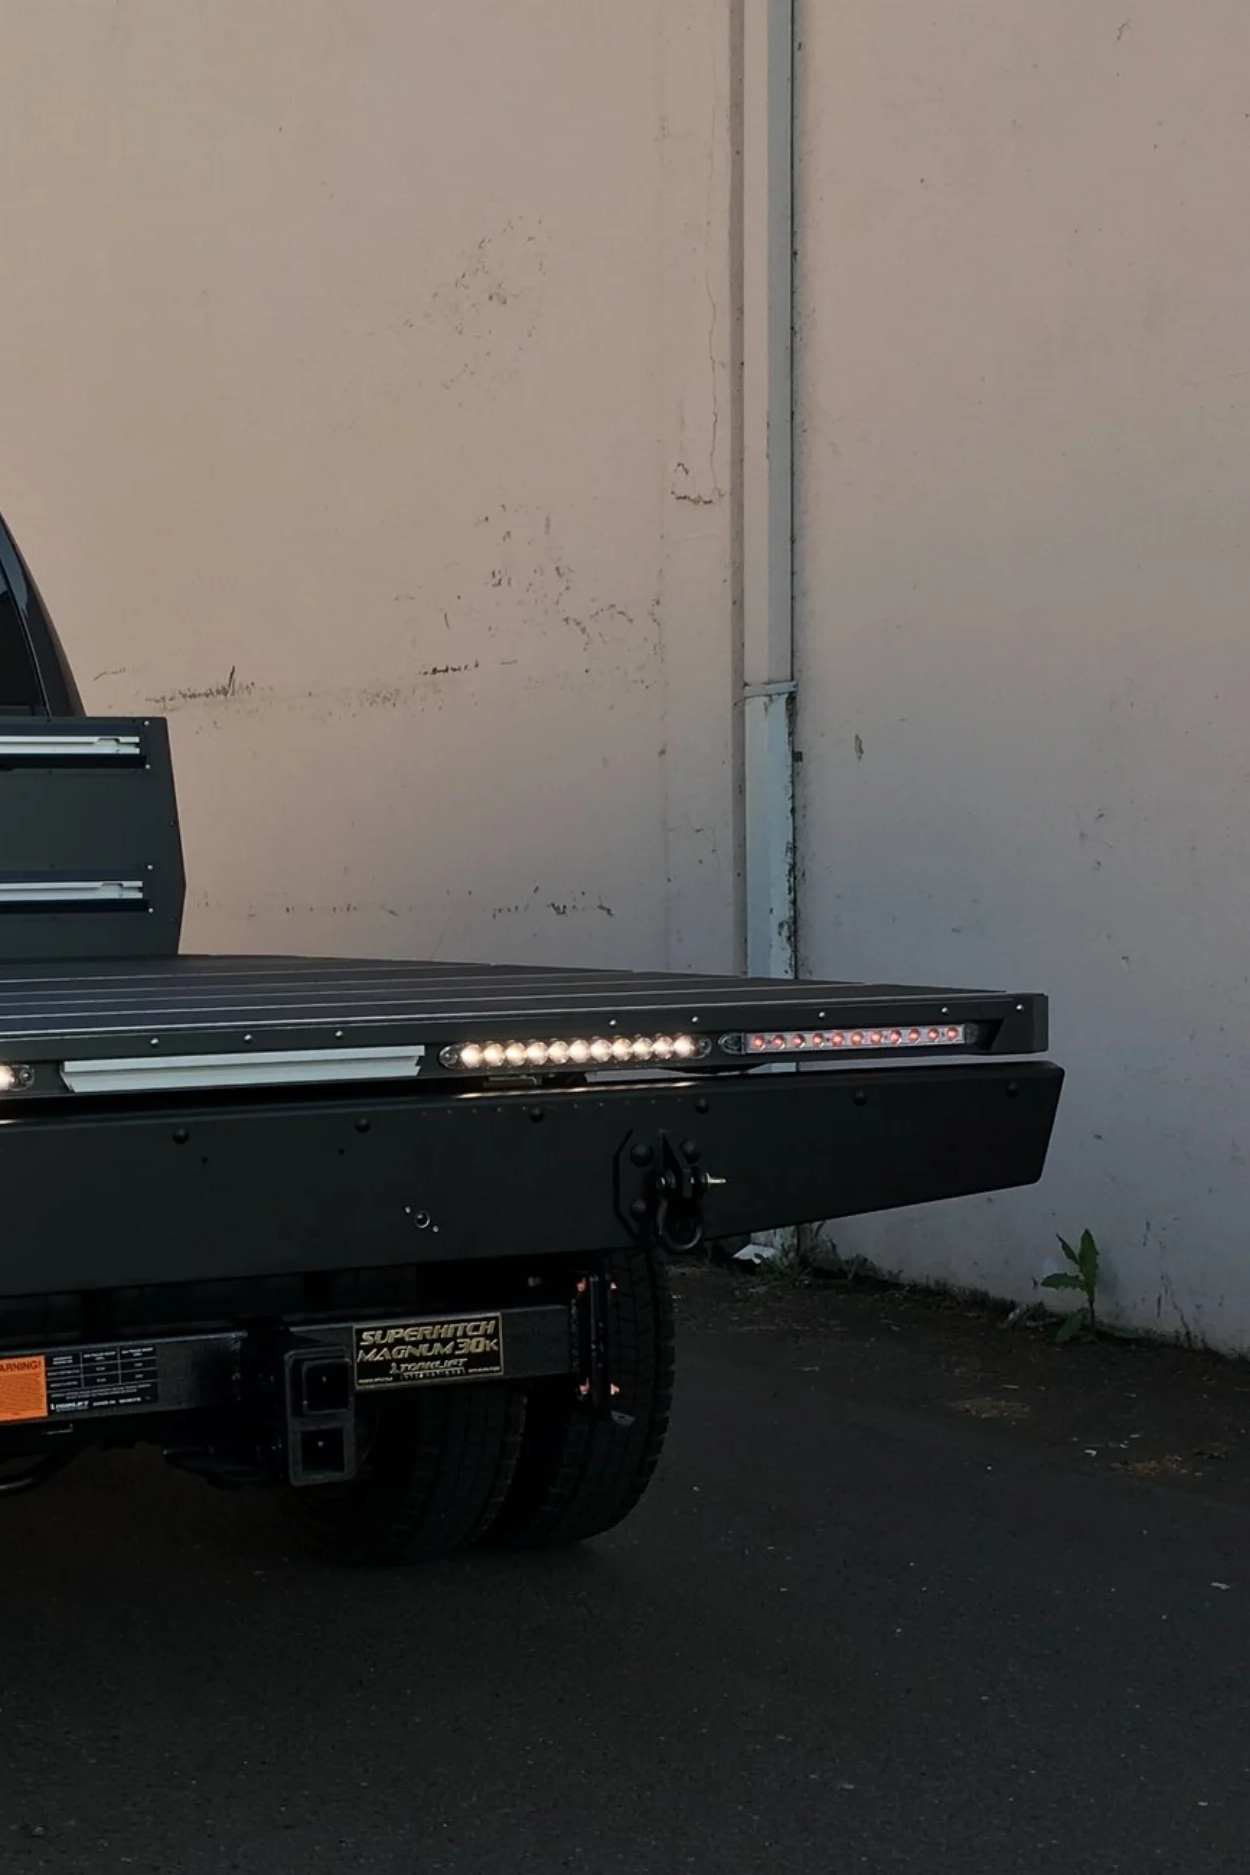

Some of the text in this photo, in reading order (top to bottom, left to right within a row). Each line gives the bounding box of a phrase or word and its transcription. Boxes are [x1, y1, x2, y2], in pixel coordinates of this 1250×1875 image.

[360, 1320, 496, 1346] SUPERHITCH
[357, 1337, 499, 1362] MAGNUM 30K
